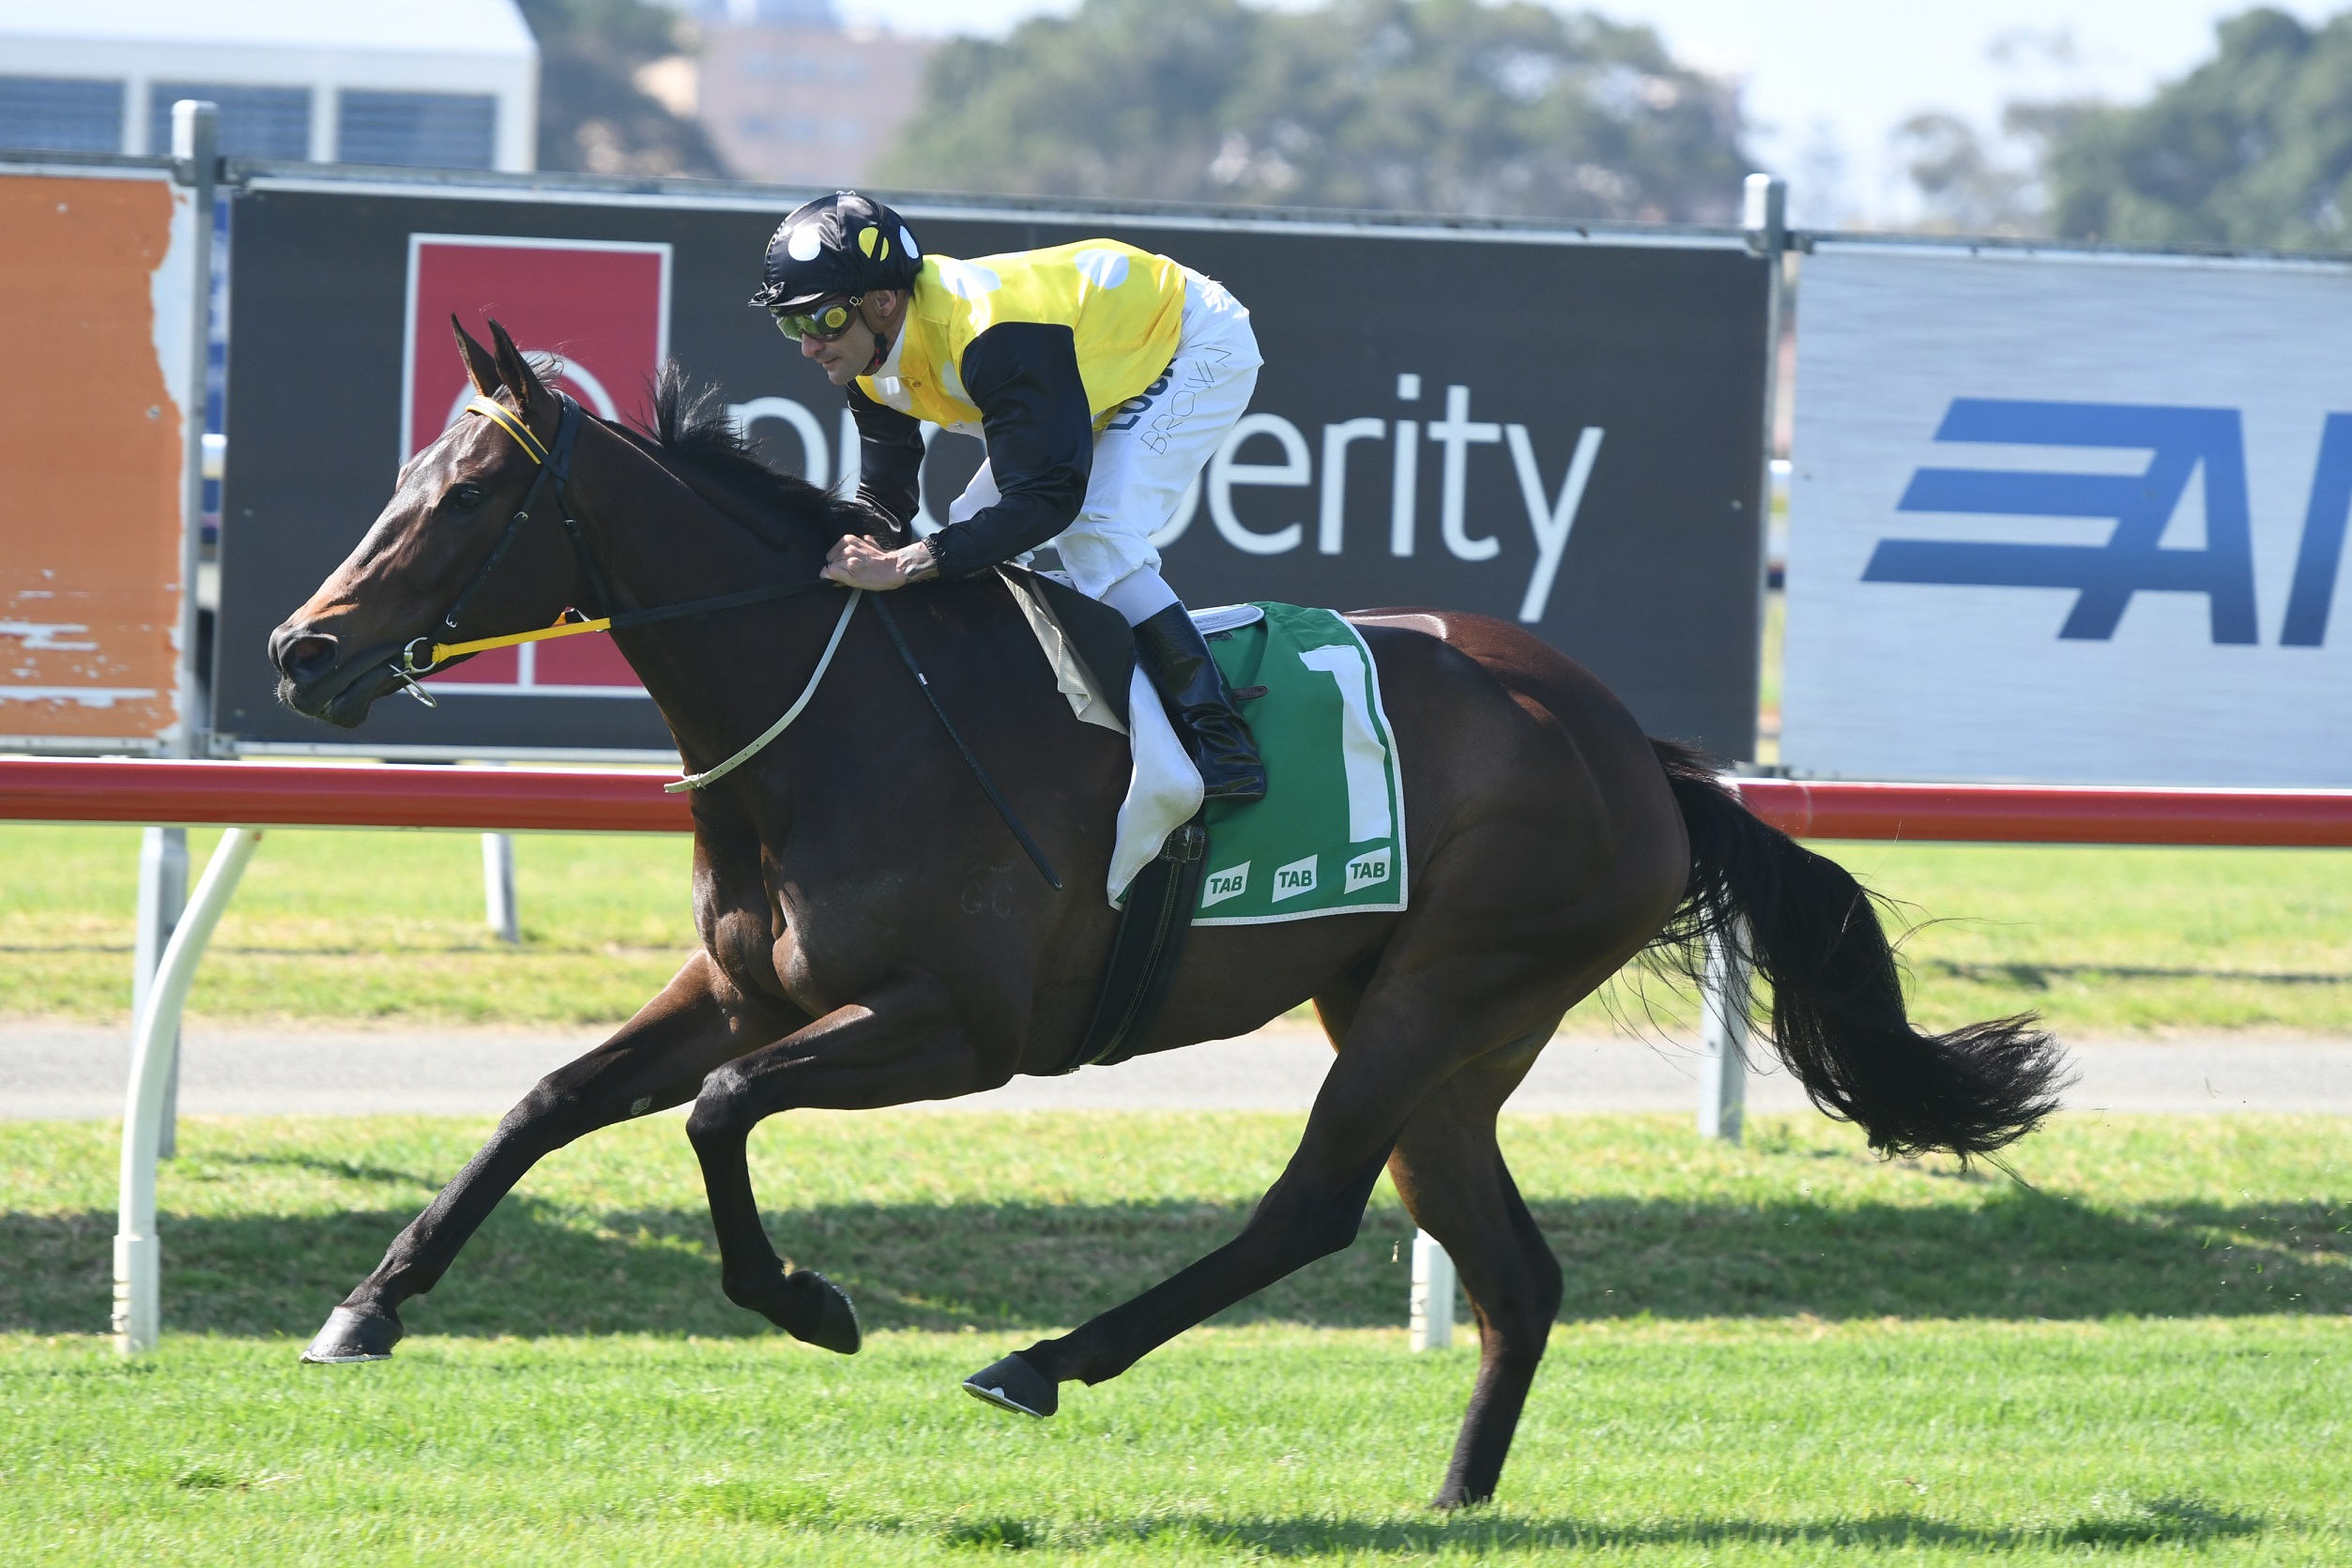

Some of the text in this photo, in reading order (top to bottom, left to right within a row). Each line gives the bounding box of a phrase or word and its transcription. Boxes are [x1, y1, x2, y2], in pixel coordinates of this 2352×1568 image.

[1140, 346, 1232, 455] BROWN
[725, 373, 1606, 624] erity
[1210, 861, 1386, 895] TAB TAB TAB
